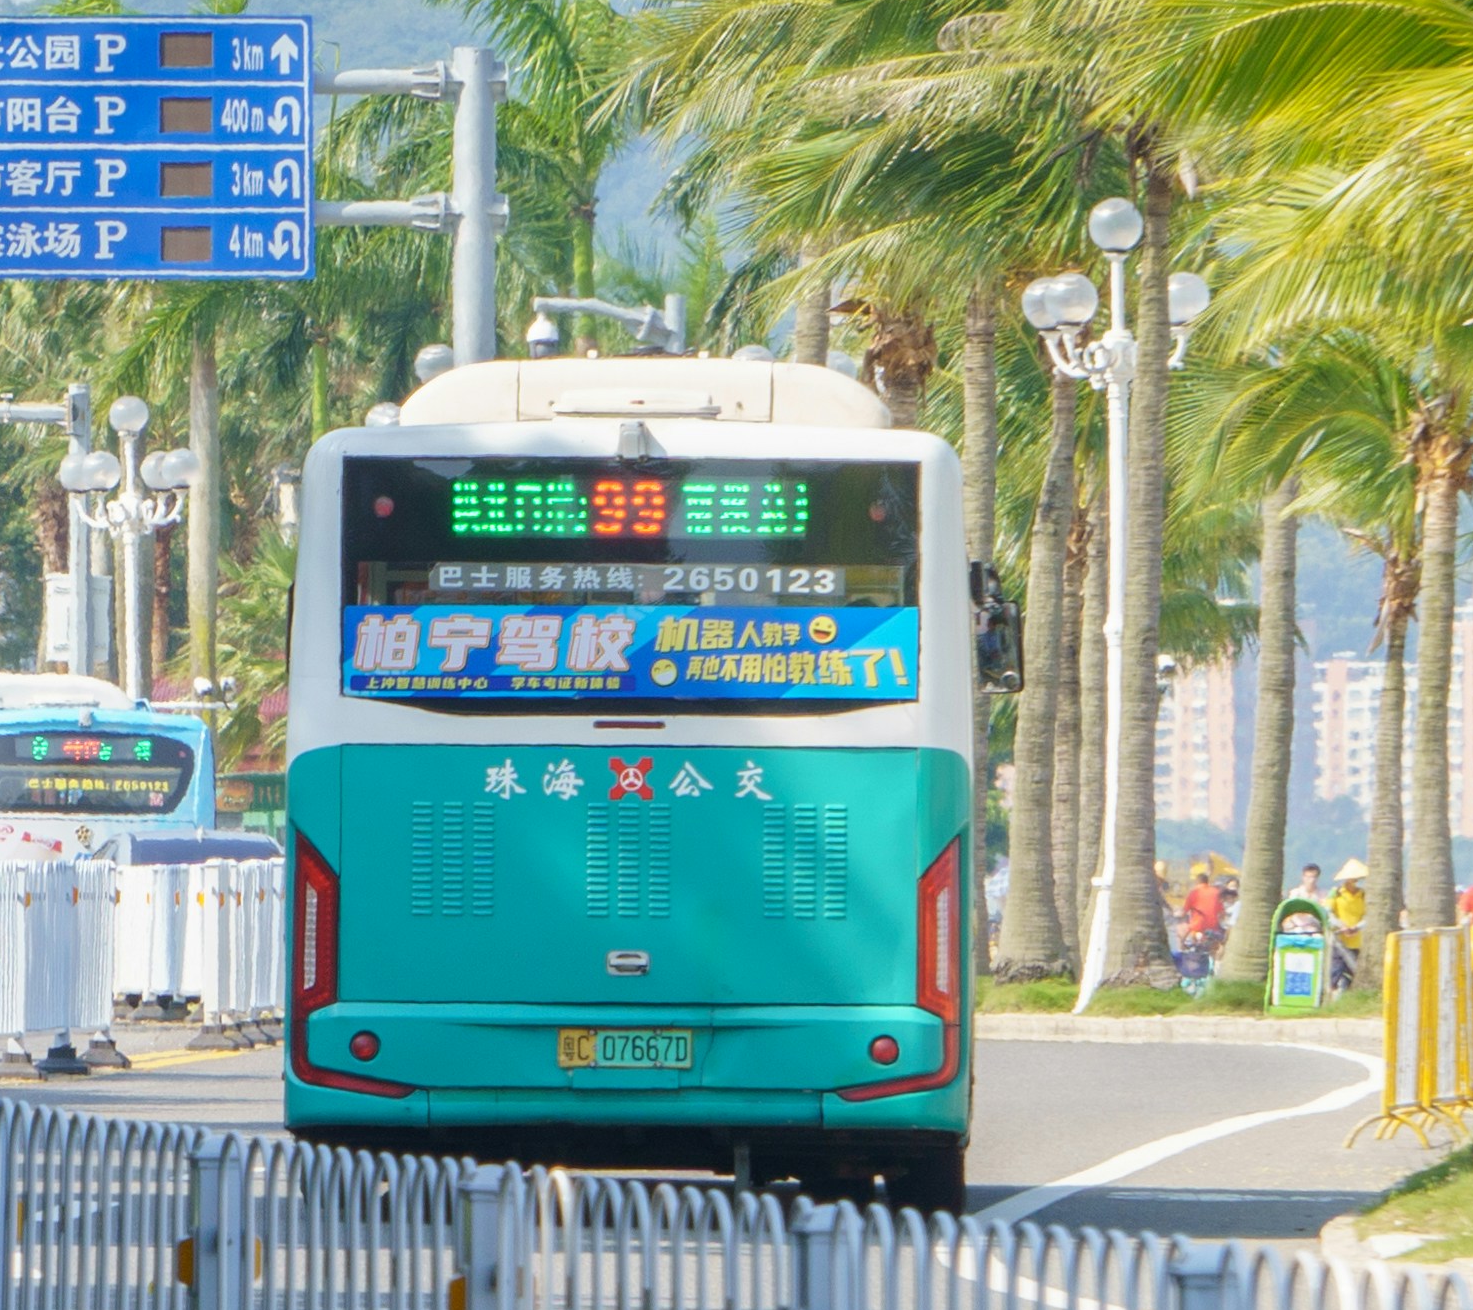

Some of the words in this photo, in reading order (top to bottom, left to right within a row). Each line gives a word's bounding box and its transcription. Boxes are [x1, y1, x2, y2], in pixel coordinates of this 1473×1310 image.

[94, 34, 126, 73] P
[231, 37, 241, 71] 3
[243, 37, 264, 71] km
[94, 96, 126, 135] P
[221, 98, 249, 133] 400
[251, 106, 264, 132] m
[94, 159, 127, 198] P
[231, 162, 241, 196] 3
[243, 162, 264, 196] km
[94, 221, 128, 260] P
[228, 224, 241, 259] 4
[243, 224, 264, 259] km
[438, 566, 645, 591] 巴士服务热线:
[663, 567, 837, 594] 2650123
[353, 613, 637, 673] 柏宁驾校
[654, 615, 801, 653] 机器人教学
[686, 648, 909, 688] 再也不用怕教练了!
[484, 758, 585, 801] 珠海
[668, 760, 773, 801] 公交
